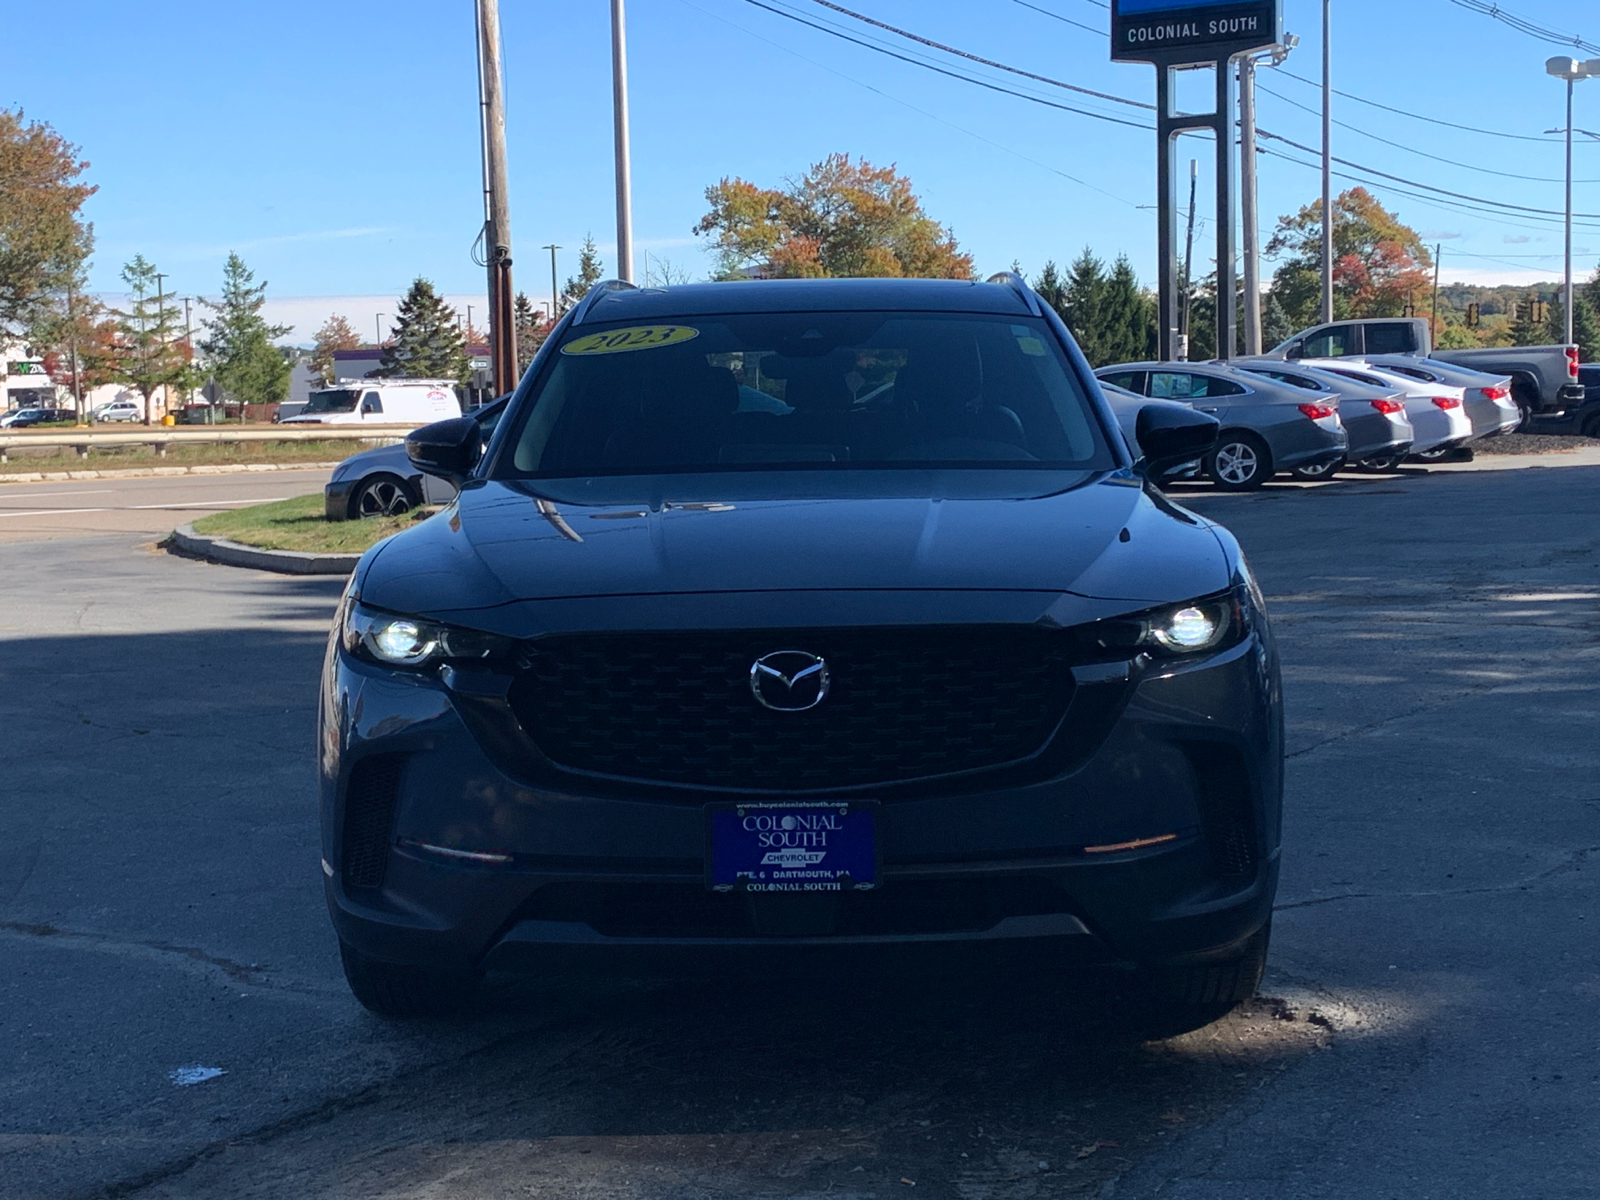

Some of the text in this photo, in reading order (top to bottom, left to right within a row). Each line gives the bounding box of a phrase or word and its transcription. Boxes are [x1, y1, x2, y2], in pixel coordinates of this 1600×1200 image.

[1128, 16, 1258, 43] COLONIAL SOUTH
[583, 327, 676, 351] 2023
[742, 814, 843, 831] COLONIAL
[758, 831, 827, 847] SOUTH
[767, 854, 820, 862] CHEVROLET
[773, 871, 834, 879] DARTMOUTH,
[746, 883, 841, 892] COLONIAL SOUTH
